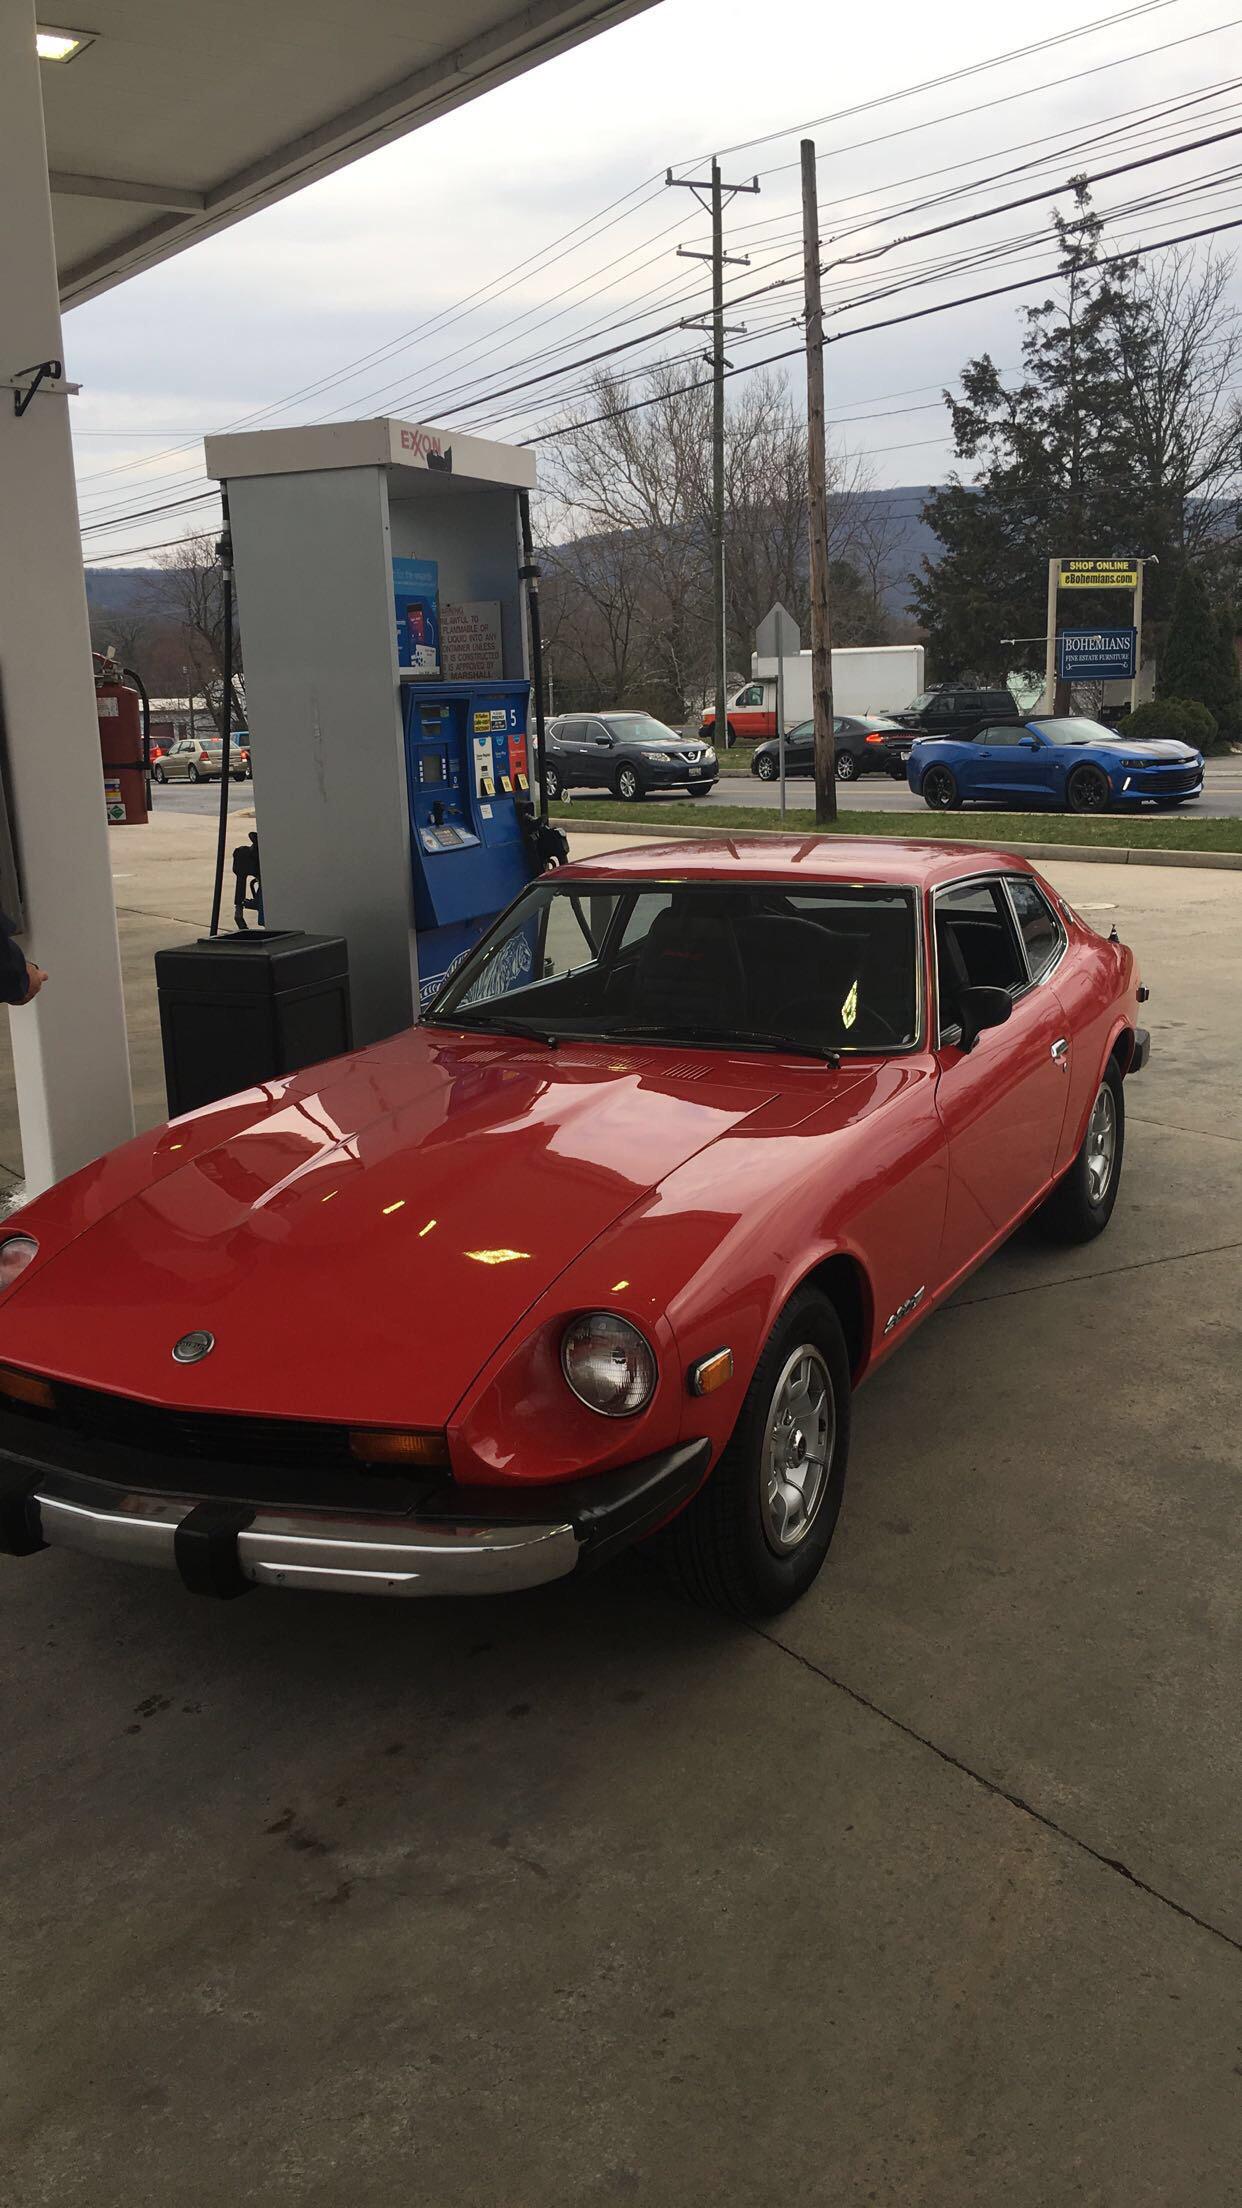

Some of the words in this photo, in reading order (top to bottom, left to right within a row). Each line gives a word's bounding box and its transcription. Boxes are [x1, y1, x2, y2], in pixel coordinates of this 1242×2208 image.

[400, 429, 443, 460] EXXON
[1069, 561, 1094, 570] SHOP
[1096, 561, 1129, 570] ONLINE
[1065, 573, 1133, 584] eBohemians.com
[441, 616, 468, 625] NLAWFUL
[471, 615, 479, 623] TO
[469, 633, 483, 642] INTO
[486, 632, 497, 640] ANY
[442, 644, 470, 653] ONTAINER
[472, 642, 496, 651] UNLESS
[1065, 637, 1131, 651] BOHEMIANS
[1065, 654, 1078, 662] FINE
[1079, 653, 1099, 662] ESTATE
[1099, 653, 1129, 661] FURNITURE
[456, 662, 486, 671] APPROVED
[487, 661, 495, 669] BY
[450, 671, 492, 680] MARSHALL
[510, 709, 517, 727] 5
